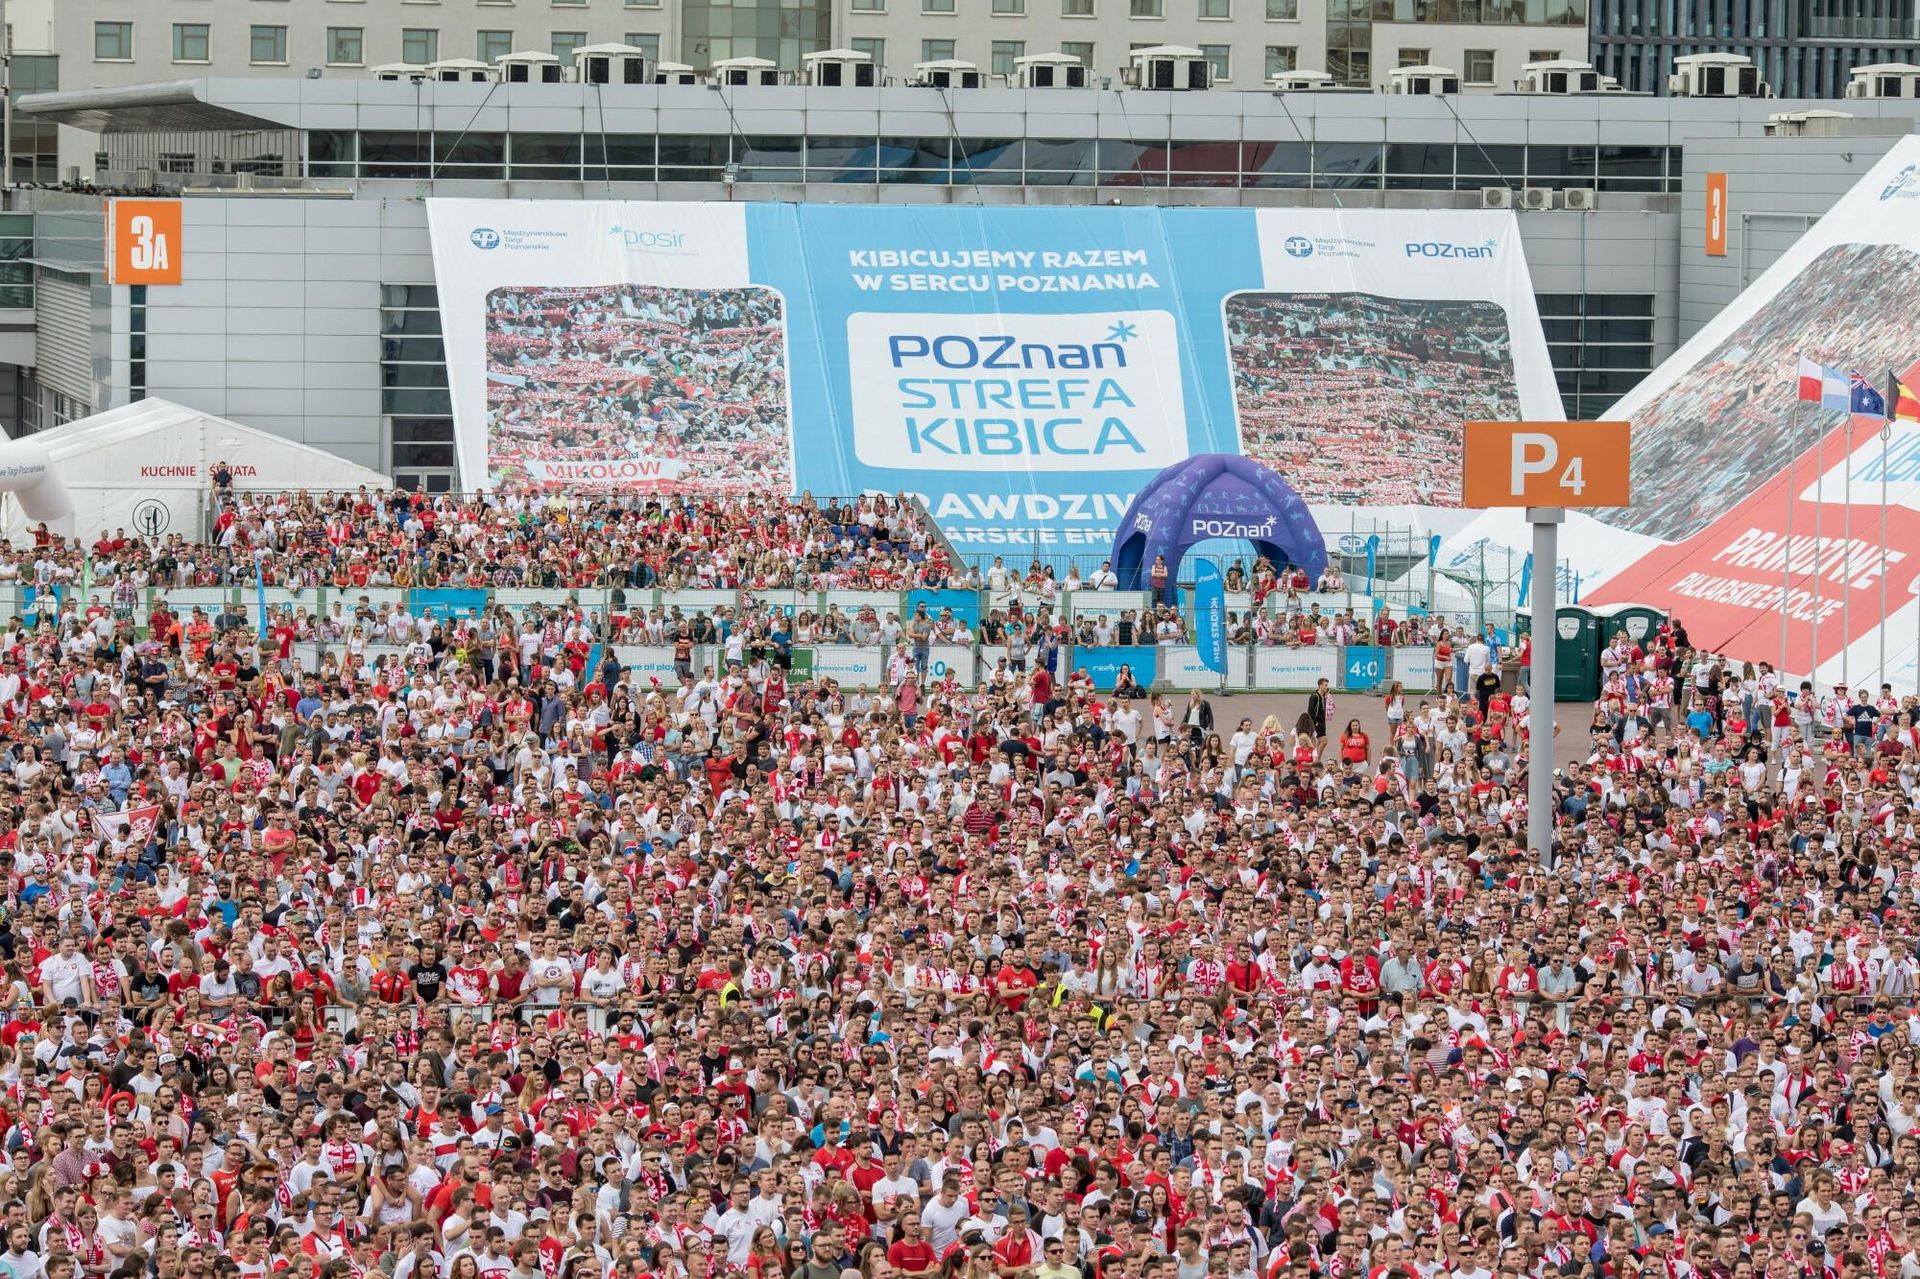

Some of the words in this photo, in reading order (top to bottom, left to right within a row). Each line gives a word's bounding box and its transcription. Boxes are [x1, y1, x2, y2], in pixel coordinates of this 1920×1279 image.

[131, 215, 169, 270] 3A
[624, 230, 685, 248] posir
[850, 249, 1035, 268] KIBICUJEMY
[1042, 249, 1148, 268] RAZEM
[852, 274, 883, 291] W
[889, 274, 990, 292] SERCU
[997, 272, 1160, 292] POZNANIA
[898, 377, 1136, 410] STREFA
[905, 416, 1147, 455] KIBICA
[141, 465, 197, 477] KUCHNIE
[209, 463, 257, 477] ŚIATA
[941, 526, 1059, 544] ARSKIE
[1210, 597, 1219, 639] STADION
[1350, 660, 1378, 677] 4:0
